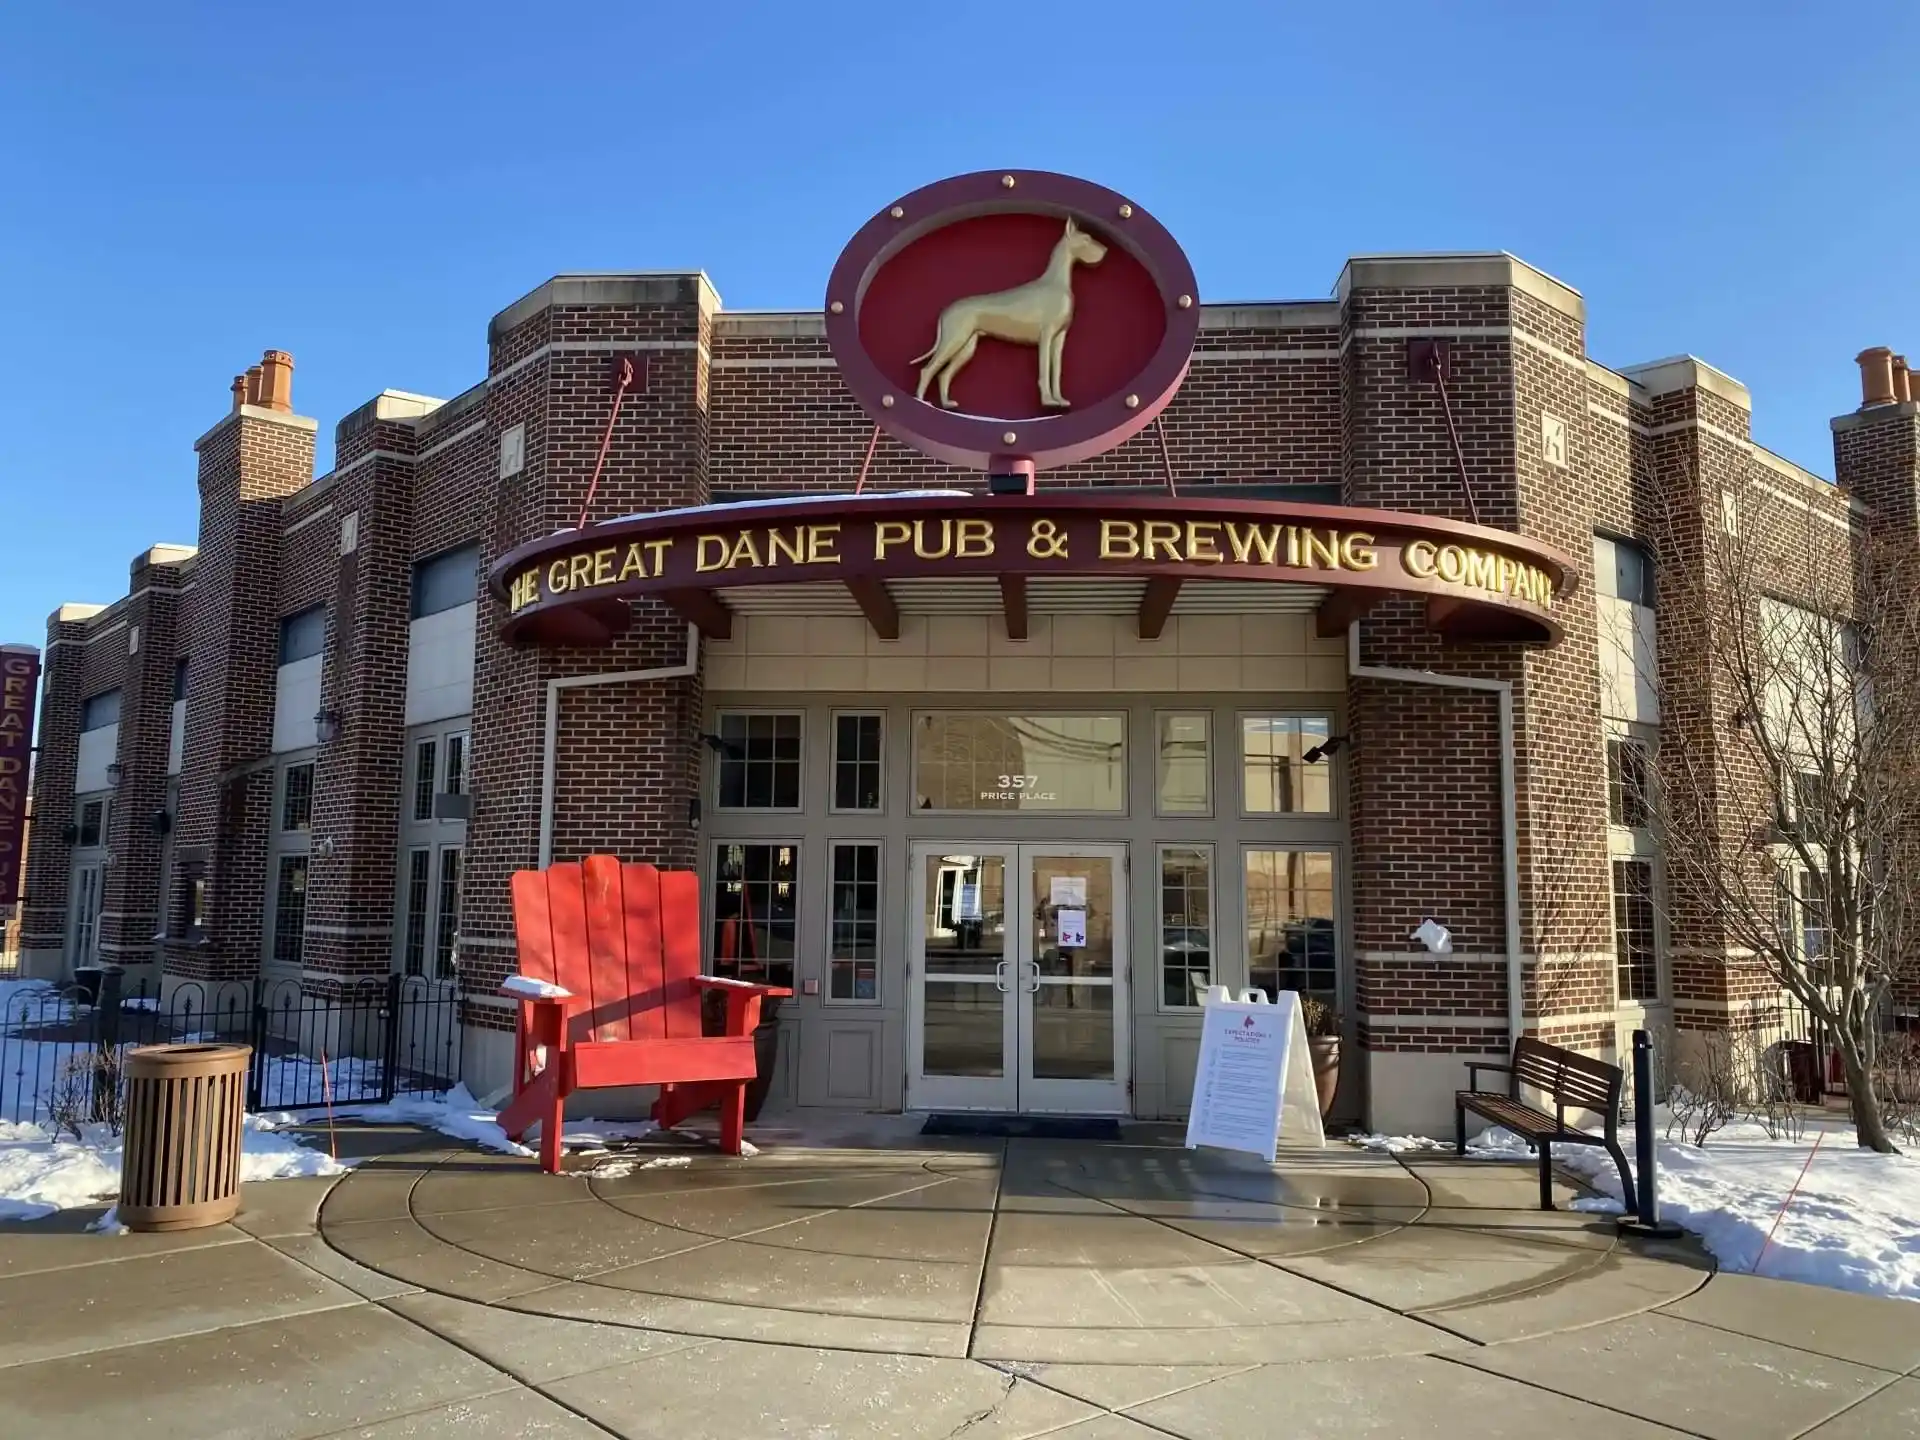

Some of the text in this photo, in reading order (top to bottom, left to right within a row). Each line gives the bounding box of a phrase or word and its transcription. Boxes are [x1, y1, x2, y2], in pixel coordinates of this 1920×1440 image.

[548, 538, 674, 595] GREAT
[696, 522, 842, 573] DANE
[874, 519, 996, 561] PUB
[1026, 519, 1069, 560] &
[1099, 519, 1379, 571] BREWING
[0, 658, 31, 747] GREAT
[980, 791, 1057, 800] PRICE PLACE
[997, 774, 1039, 788] 357
